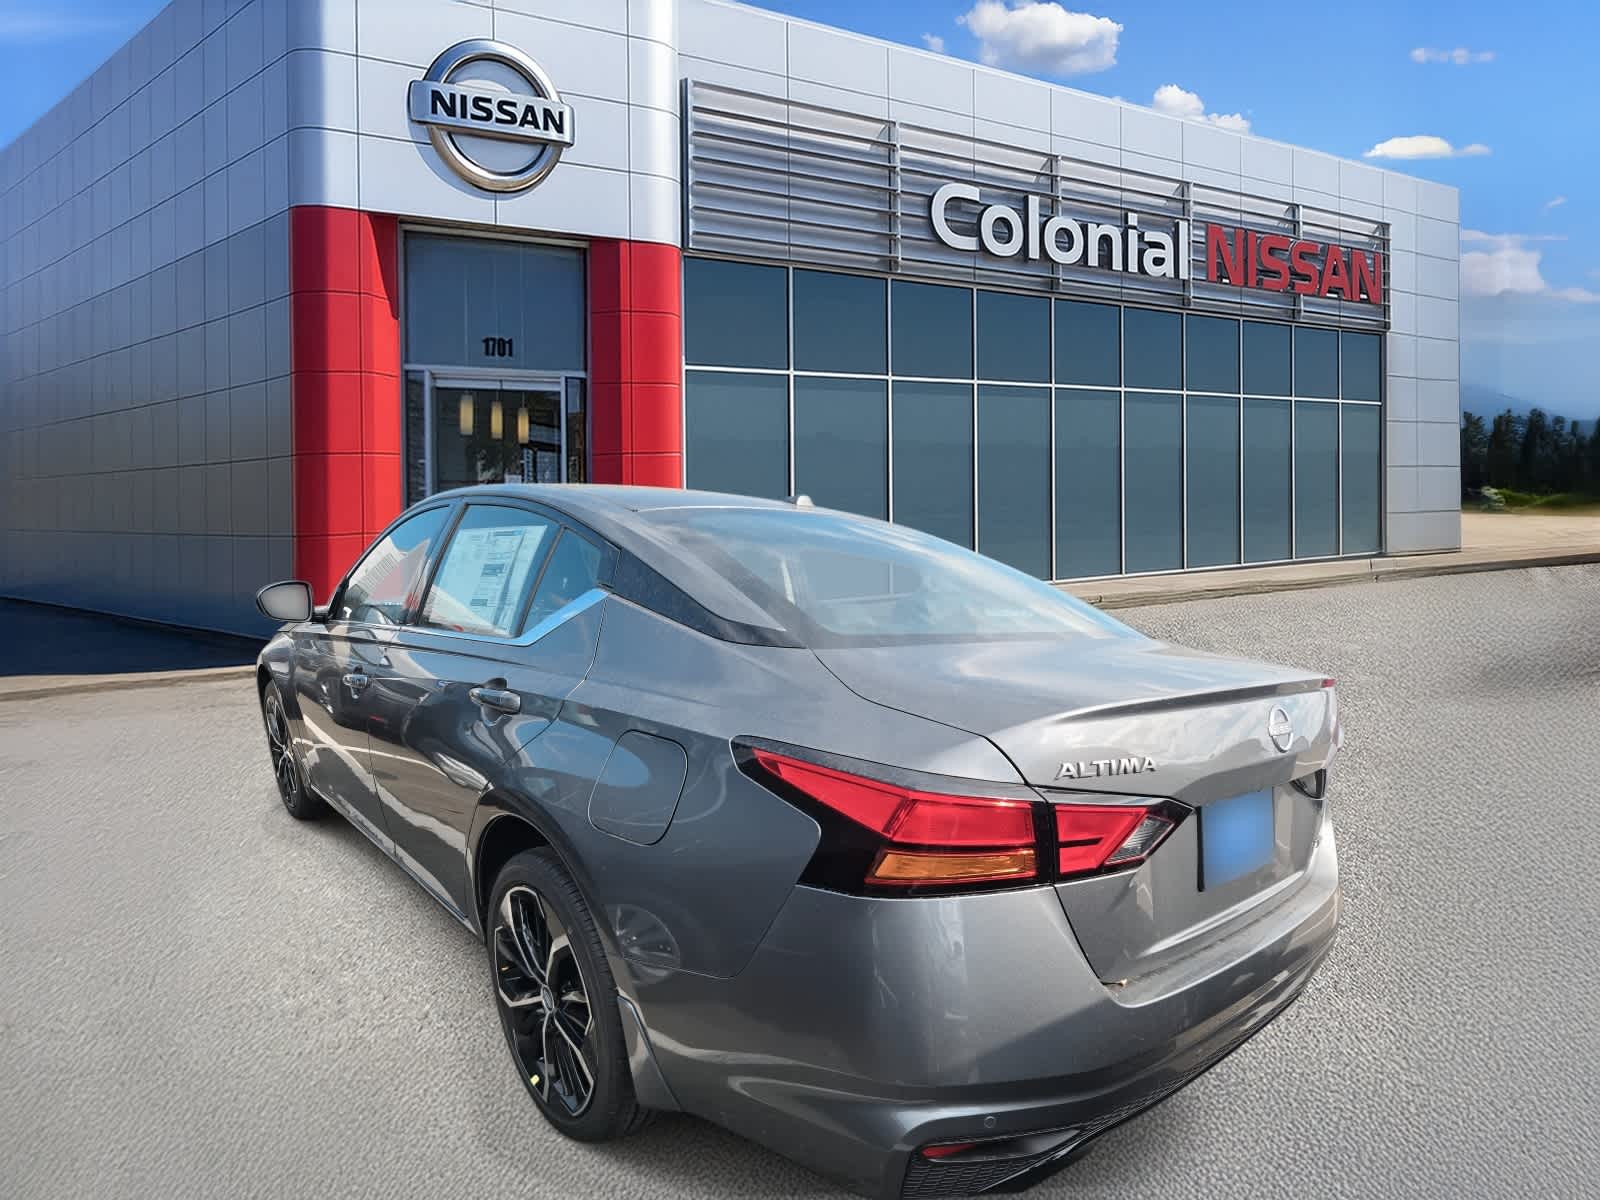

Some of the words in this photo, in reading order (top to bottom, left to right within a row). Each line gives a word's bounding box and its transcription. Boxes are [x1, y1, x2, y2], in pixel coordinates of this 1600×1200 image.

[431, 89, 565, 134] NISSAN
[930, 182, 1189, 281] Colonial
[1206, 223, 1382, 305] NISSAN
[482, 337, 513, 357] 1701
[1054, 756, 1157, 780] ALTIMA
